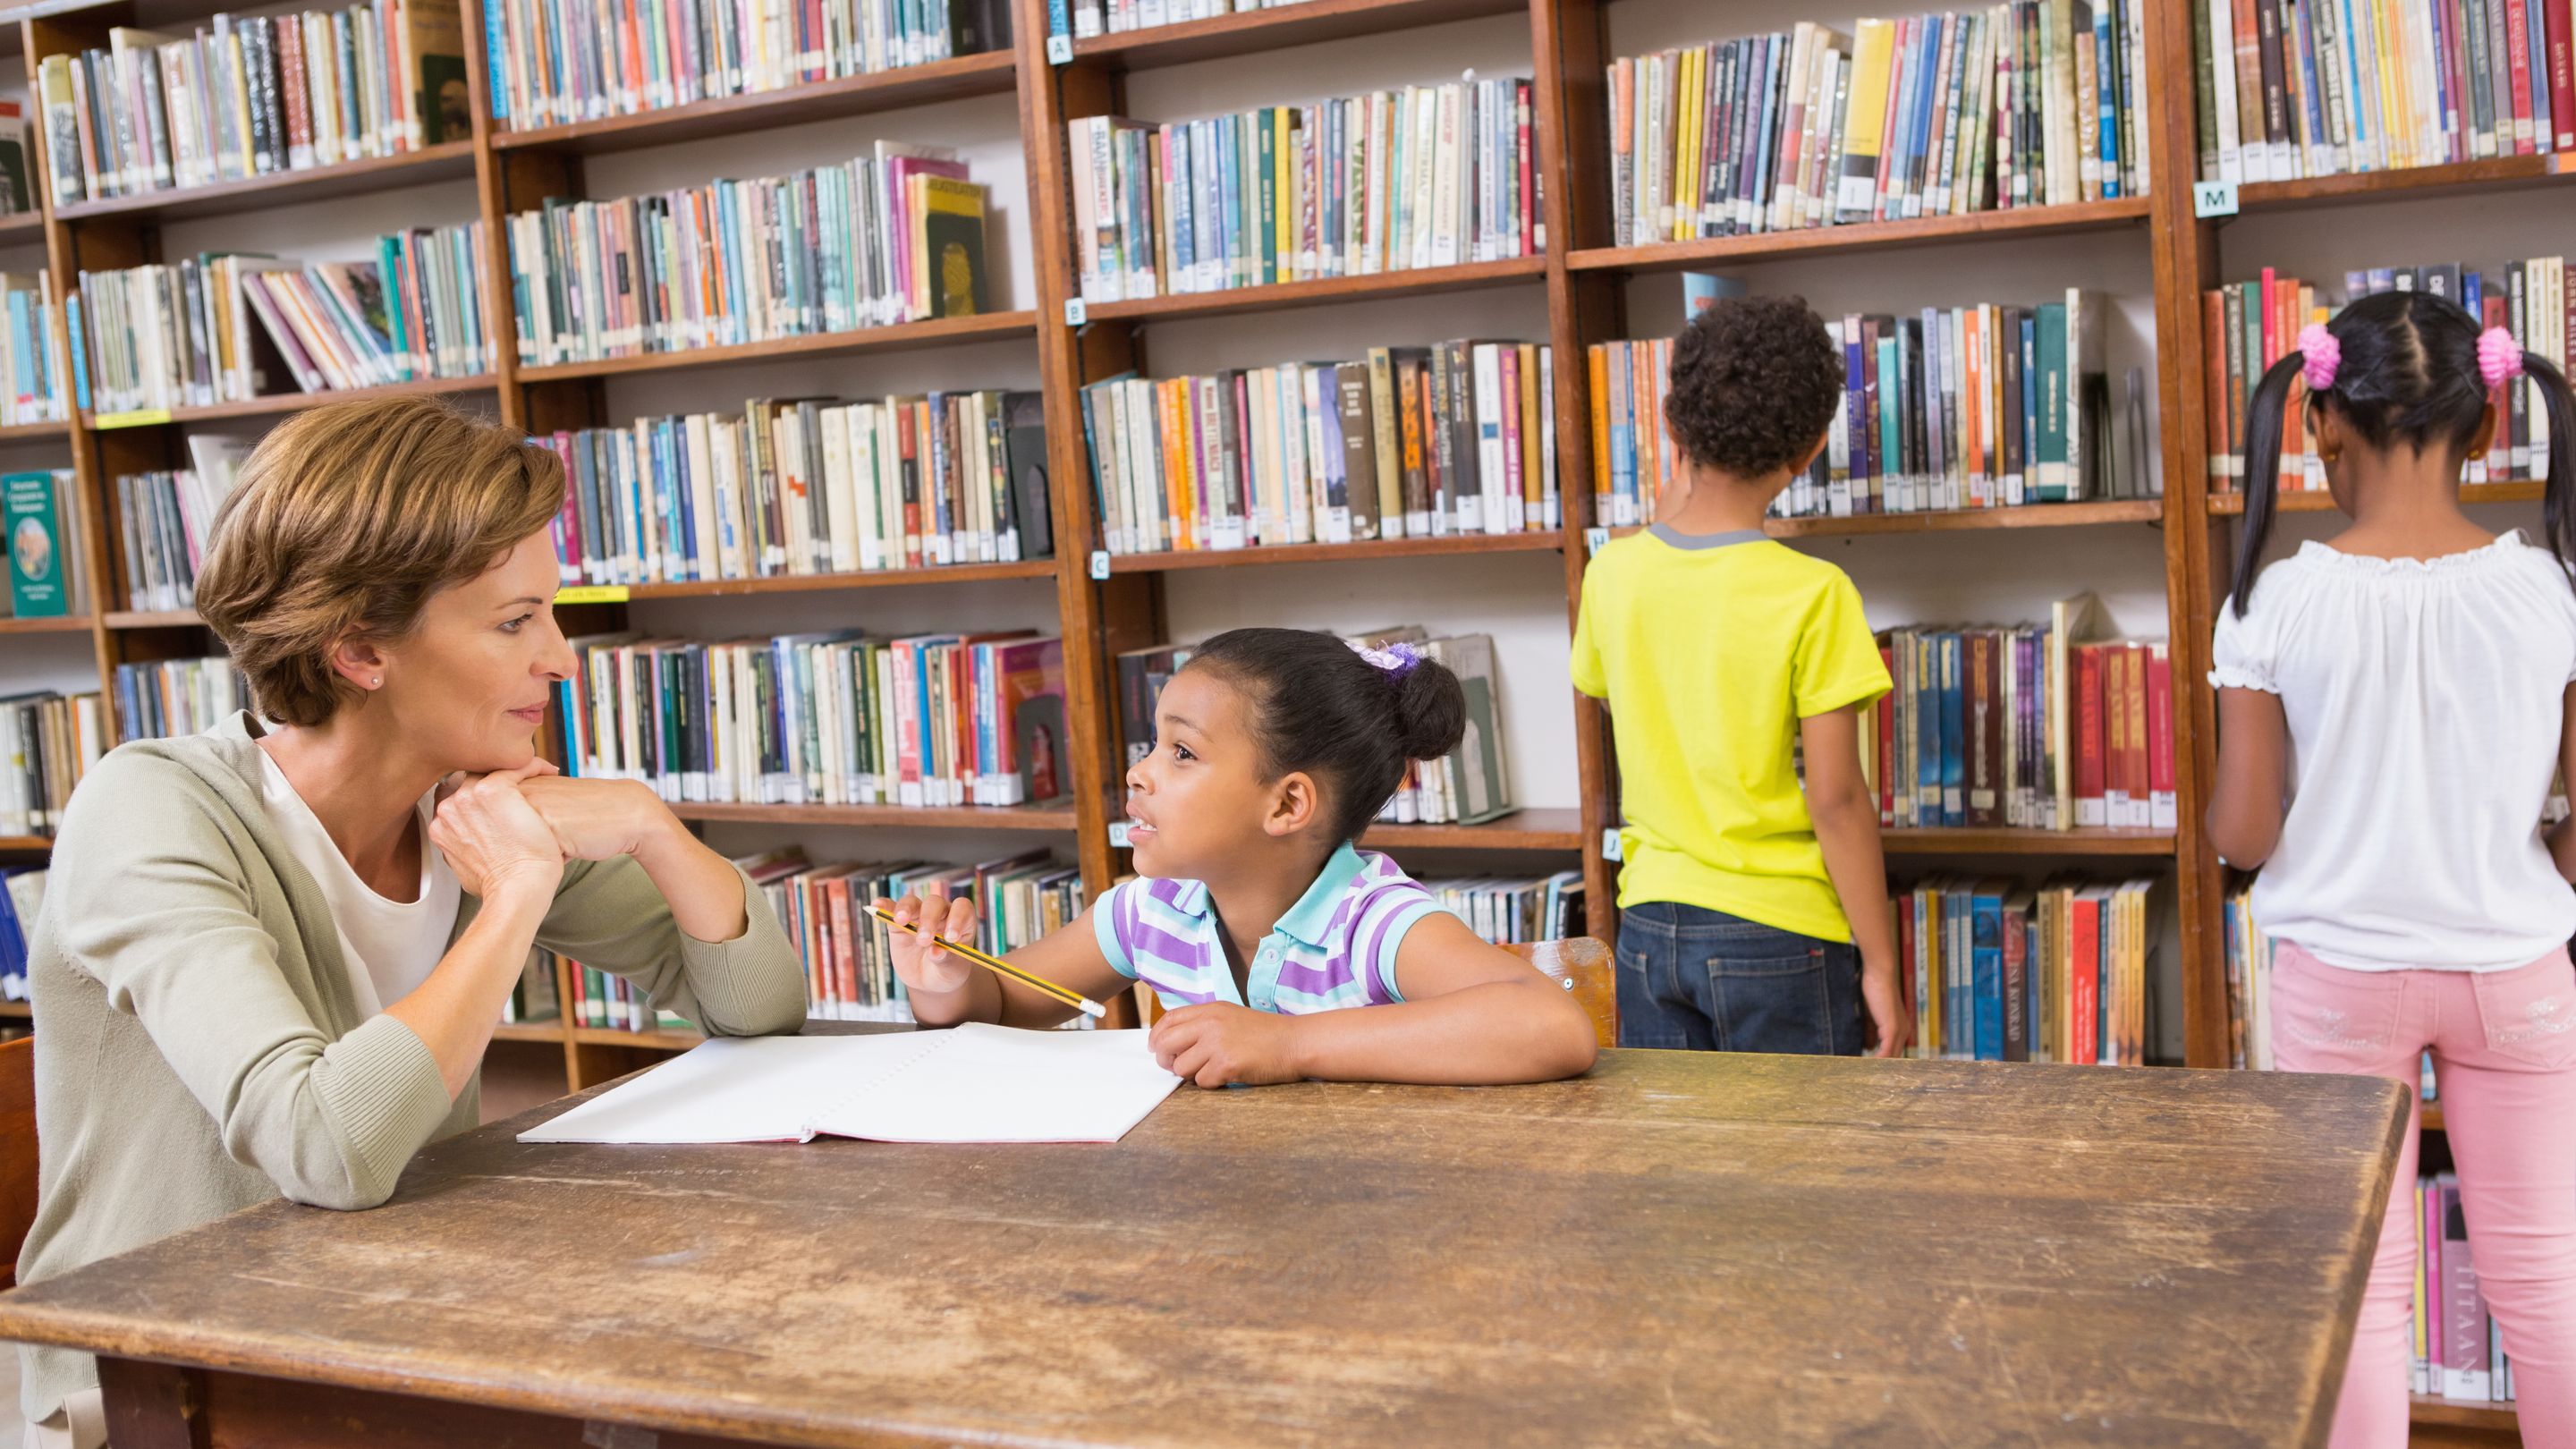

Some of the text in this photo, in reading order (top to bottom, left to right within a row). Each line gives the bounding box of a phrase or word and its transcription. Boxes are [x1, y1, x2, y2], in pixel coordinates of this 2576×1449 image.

[1055, 42, 1063, 54] A
[2205, 189, 2226, 207] M
[1070, 306, 1079, 319] B
[1594, 535, 1605, 550] H
[1096, 558, 1104, 573] C
[1114, 828, 1123, 839] D
[1609, 837, 1616, 852] J
